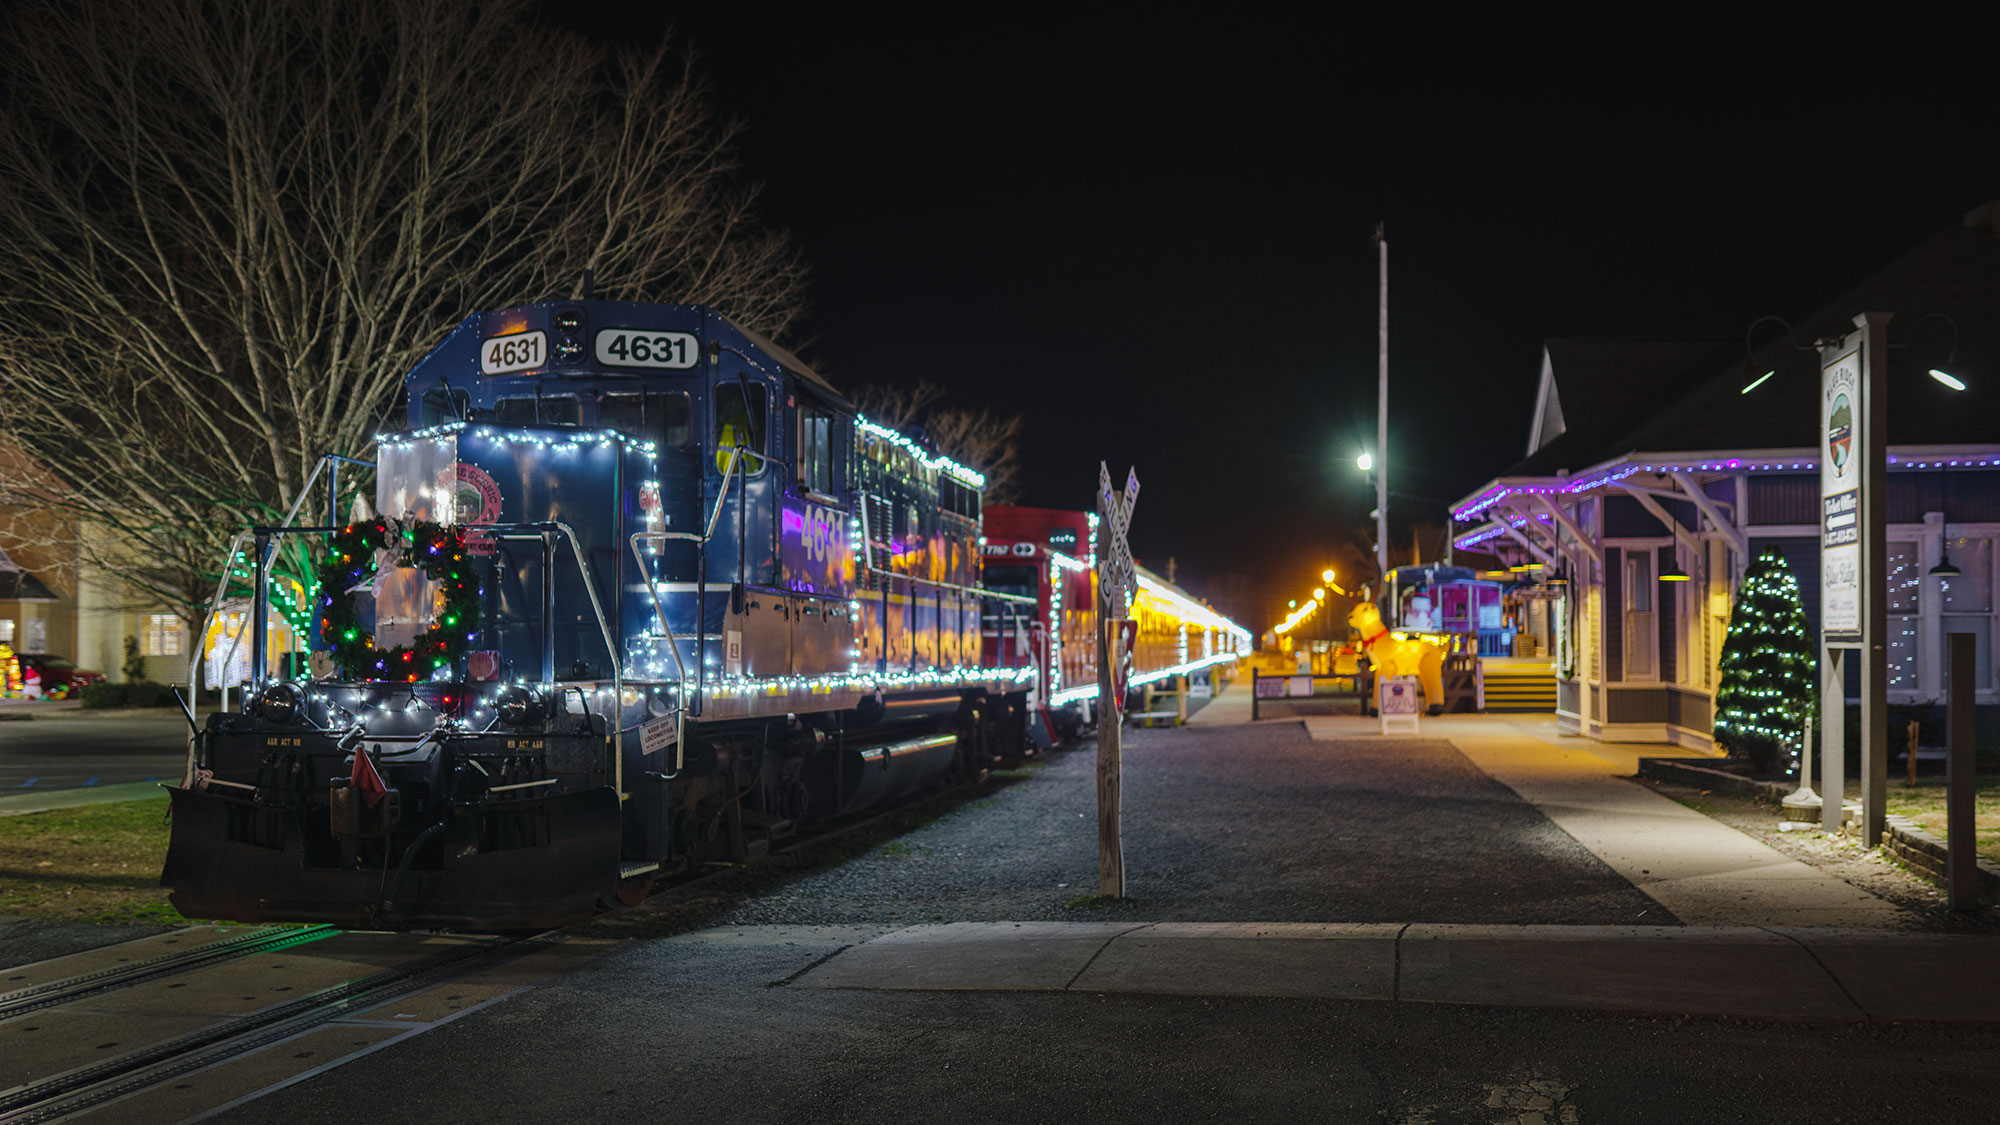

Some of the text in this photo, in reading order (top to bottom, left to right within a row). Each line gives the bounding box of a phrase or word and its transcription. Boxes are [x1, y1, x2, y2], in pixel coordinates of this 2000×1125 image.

[489, 336, 539, 369] 4631
[607, 335, 686, 364] 4631
[468, 471, 498, 504] SCENIC
[801, 504, 843, 564] 4631
[1102, 475, 1137, 597] CROSSING
[644, 727, 673, 743] LOCOMOTIVE
[647, 721, 669, 734] KEEP OFF
